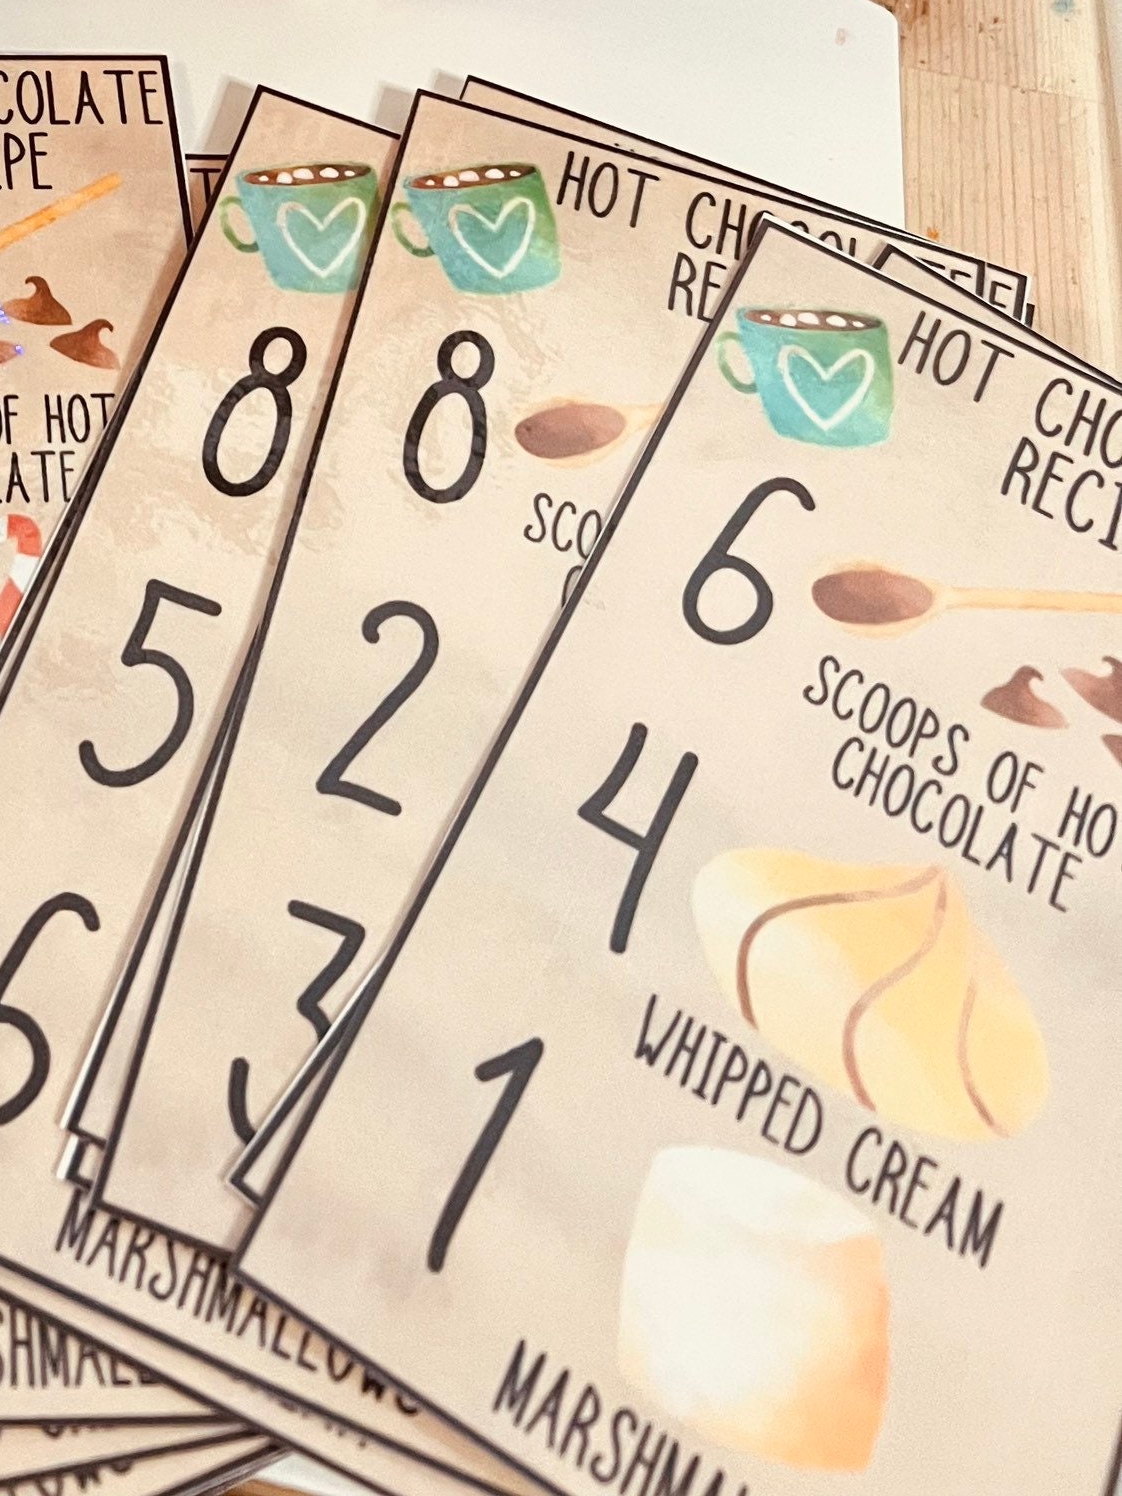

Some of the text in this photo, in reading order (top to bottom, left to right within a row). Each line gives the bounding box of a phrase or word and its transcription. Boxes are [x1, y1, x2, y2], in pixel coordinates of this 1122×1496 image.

[556, 151, 660, 228] HOT
[45, 392, 116, 446] HOT
[202, 326, 307, 497] 8
[403, 330, 495, 504] 8
[898, 310, 1014, 403] HOT
[682, 477, 815, 645] 6
[79, 578, 222, 788] 5
[316, 600, 439, 816] 2
[803, 655, 970, 777] SCOOPS
[986, 750, 1045, 813] OF
[578, 722, 699, 955] 4
[831, 736, 1084, 914] CHOCOLATE
[427, 1036, 546, 1274] 1
[633, 993, 1005, 1270] WHIPPED CREAM
